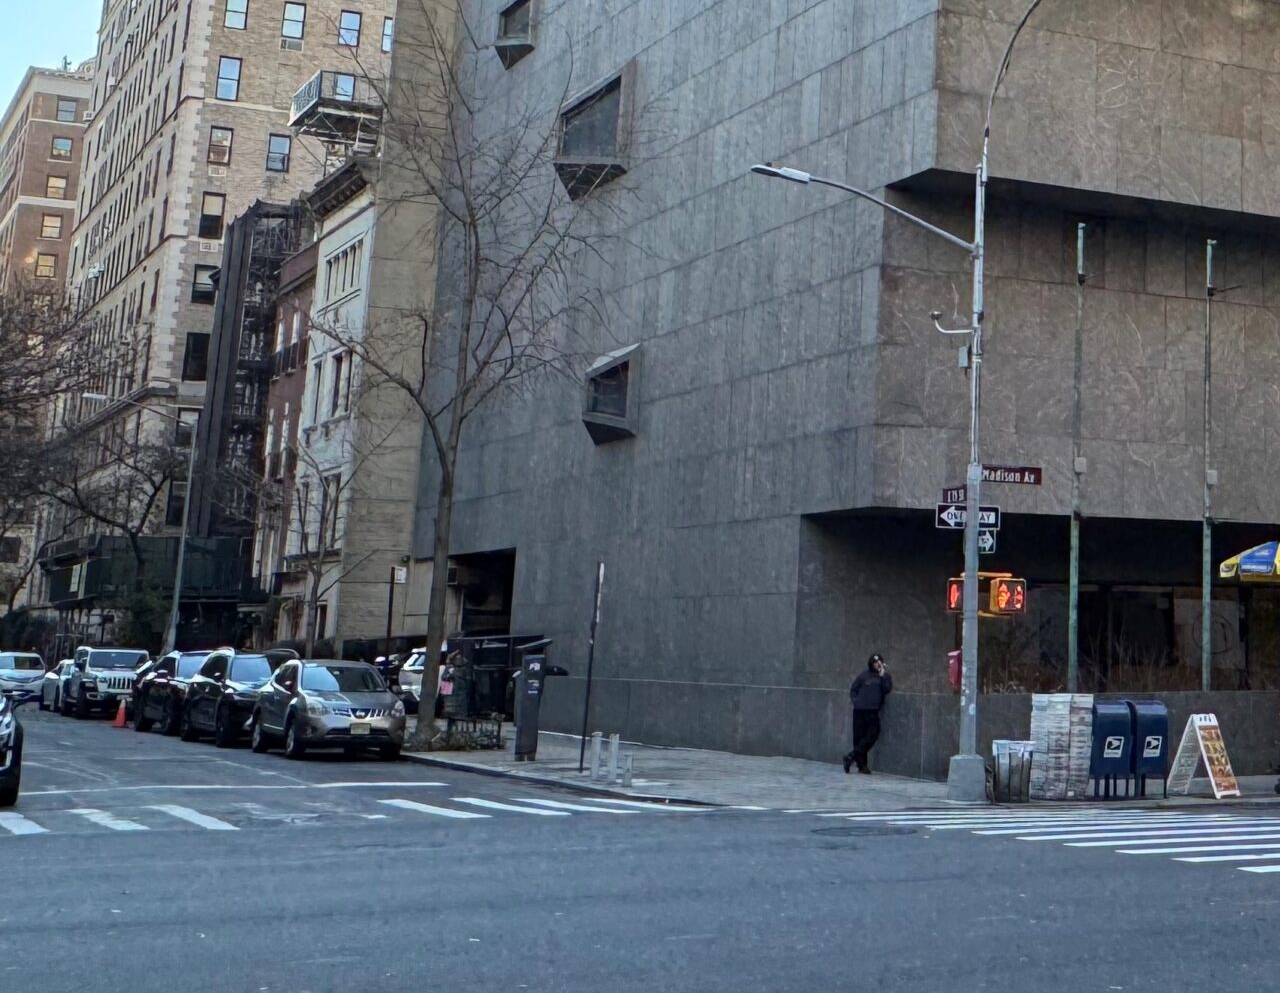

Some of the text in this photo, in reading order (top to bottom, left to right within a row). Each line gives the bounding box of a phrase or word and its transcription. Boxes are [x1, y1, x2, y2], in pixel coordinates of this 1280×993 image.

[982, 469, 1035, 483] Madison Av
[979, 511, 991, 522] AY
